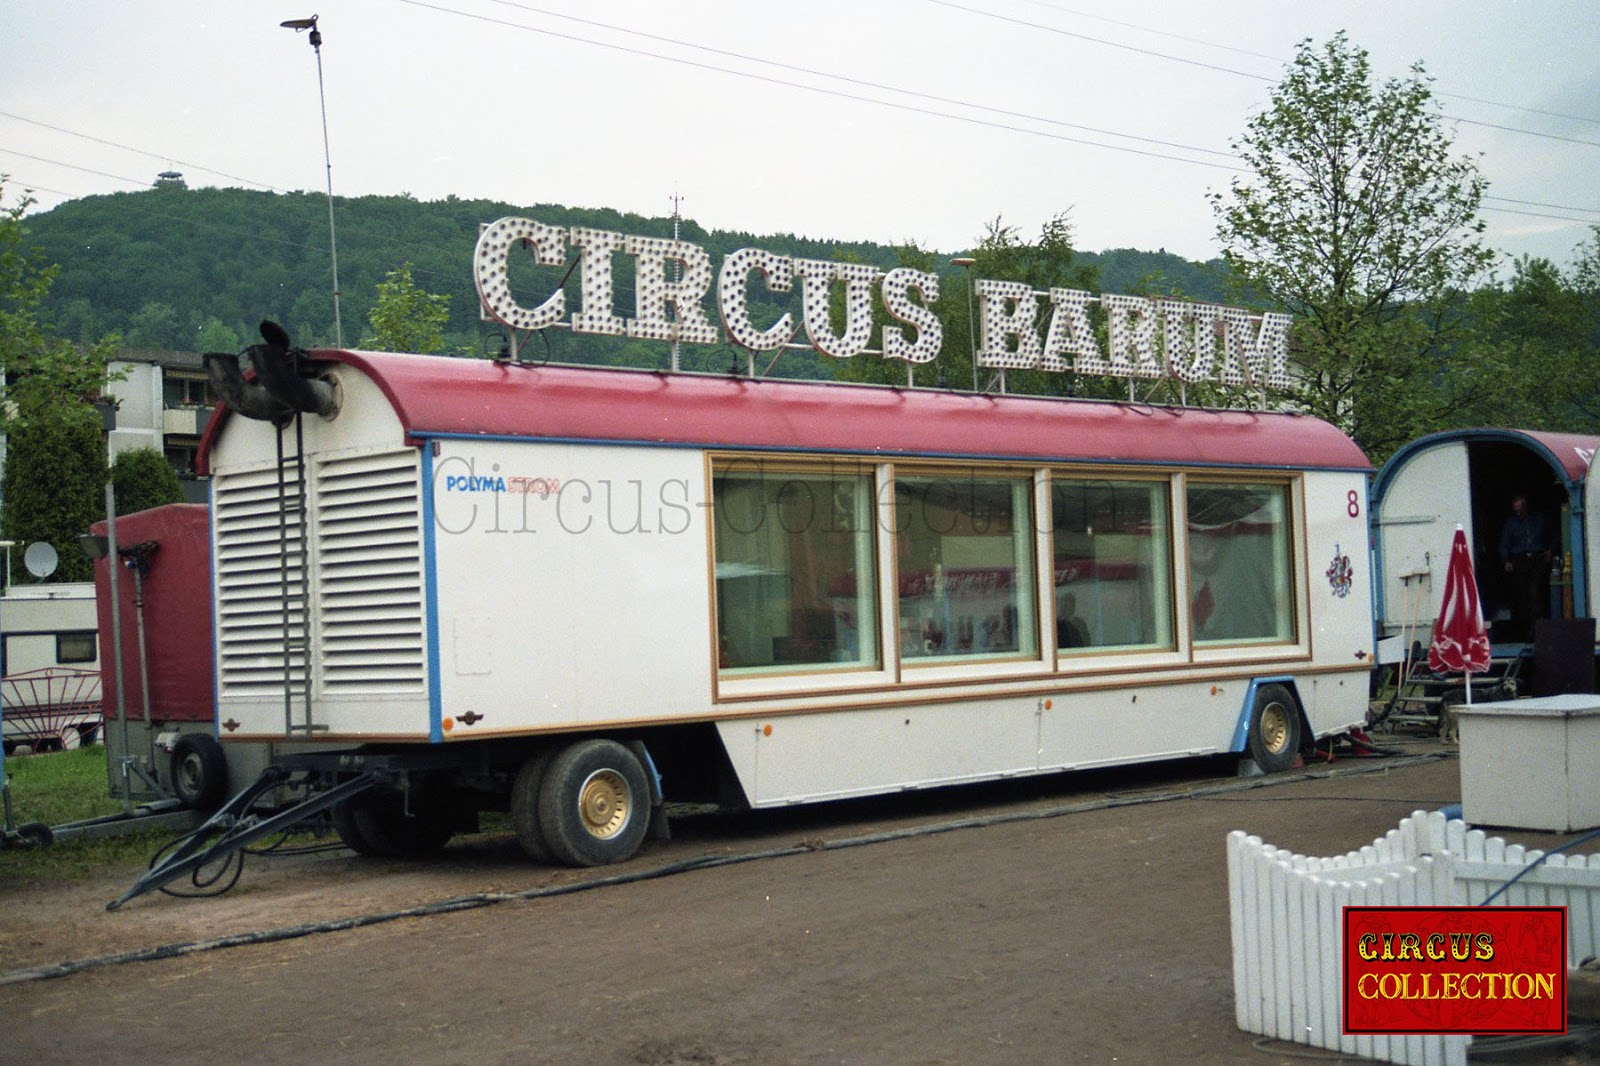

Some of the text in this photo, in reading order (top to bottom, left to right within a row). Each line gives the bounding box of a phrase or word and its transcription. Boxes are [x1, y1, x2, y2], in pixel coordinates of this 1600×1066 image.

[474, 216, 1294, 390] CIRCUS BARUM
[446, 476, 560, 494] POLYMA STROM
[1347, 490, 1360, 518] 8
